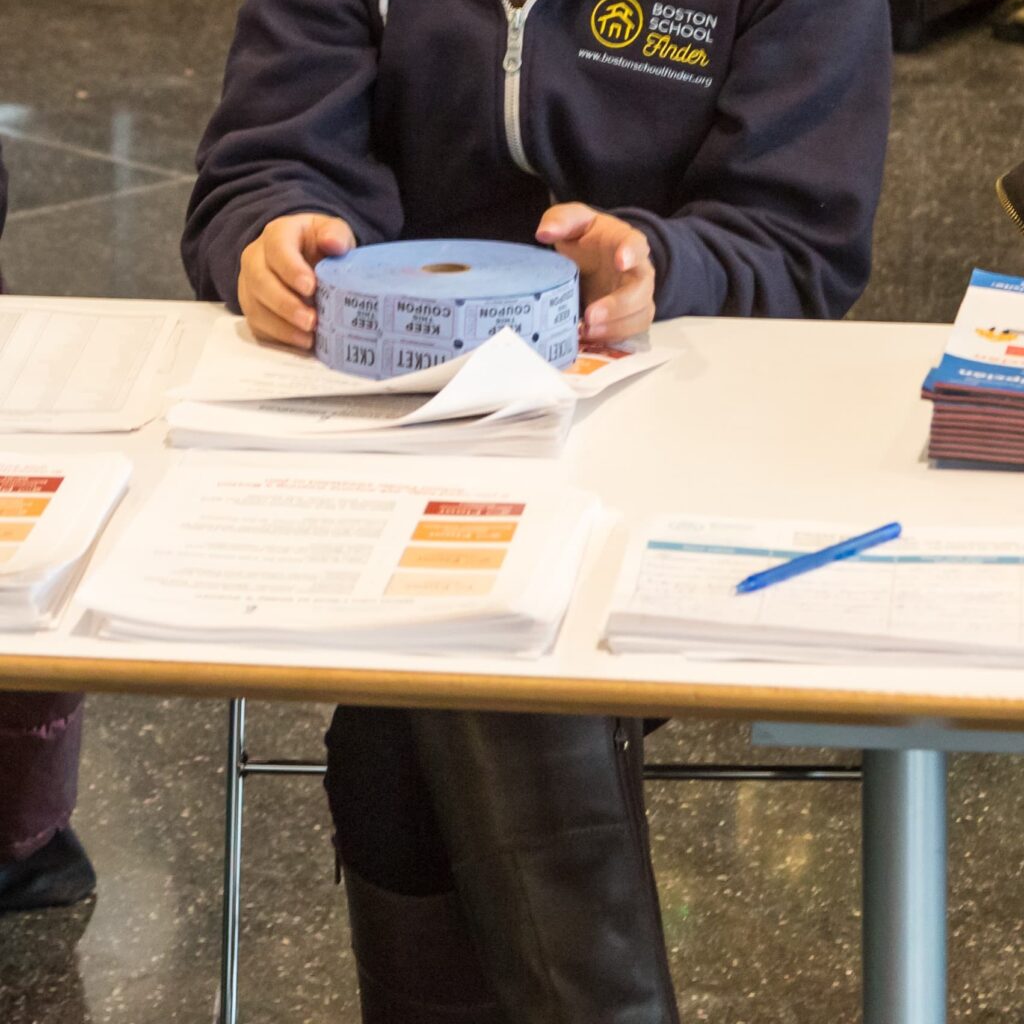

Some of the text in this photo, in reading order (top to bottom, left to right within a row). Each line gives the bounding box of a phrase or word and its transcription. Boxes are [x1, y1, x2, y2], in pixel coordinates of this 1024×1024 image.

[652, 2, 718, 29] BOSTON
[648, 17, 713, 43] SCHOOL
[397, 301, 451, 318] COUPON
[479, 304, 531, 318] COUPON
[405, 321, 440, 335] KEEP
